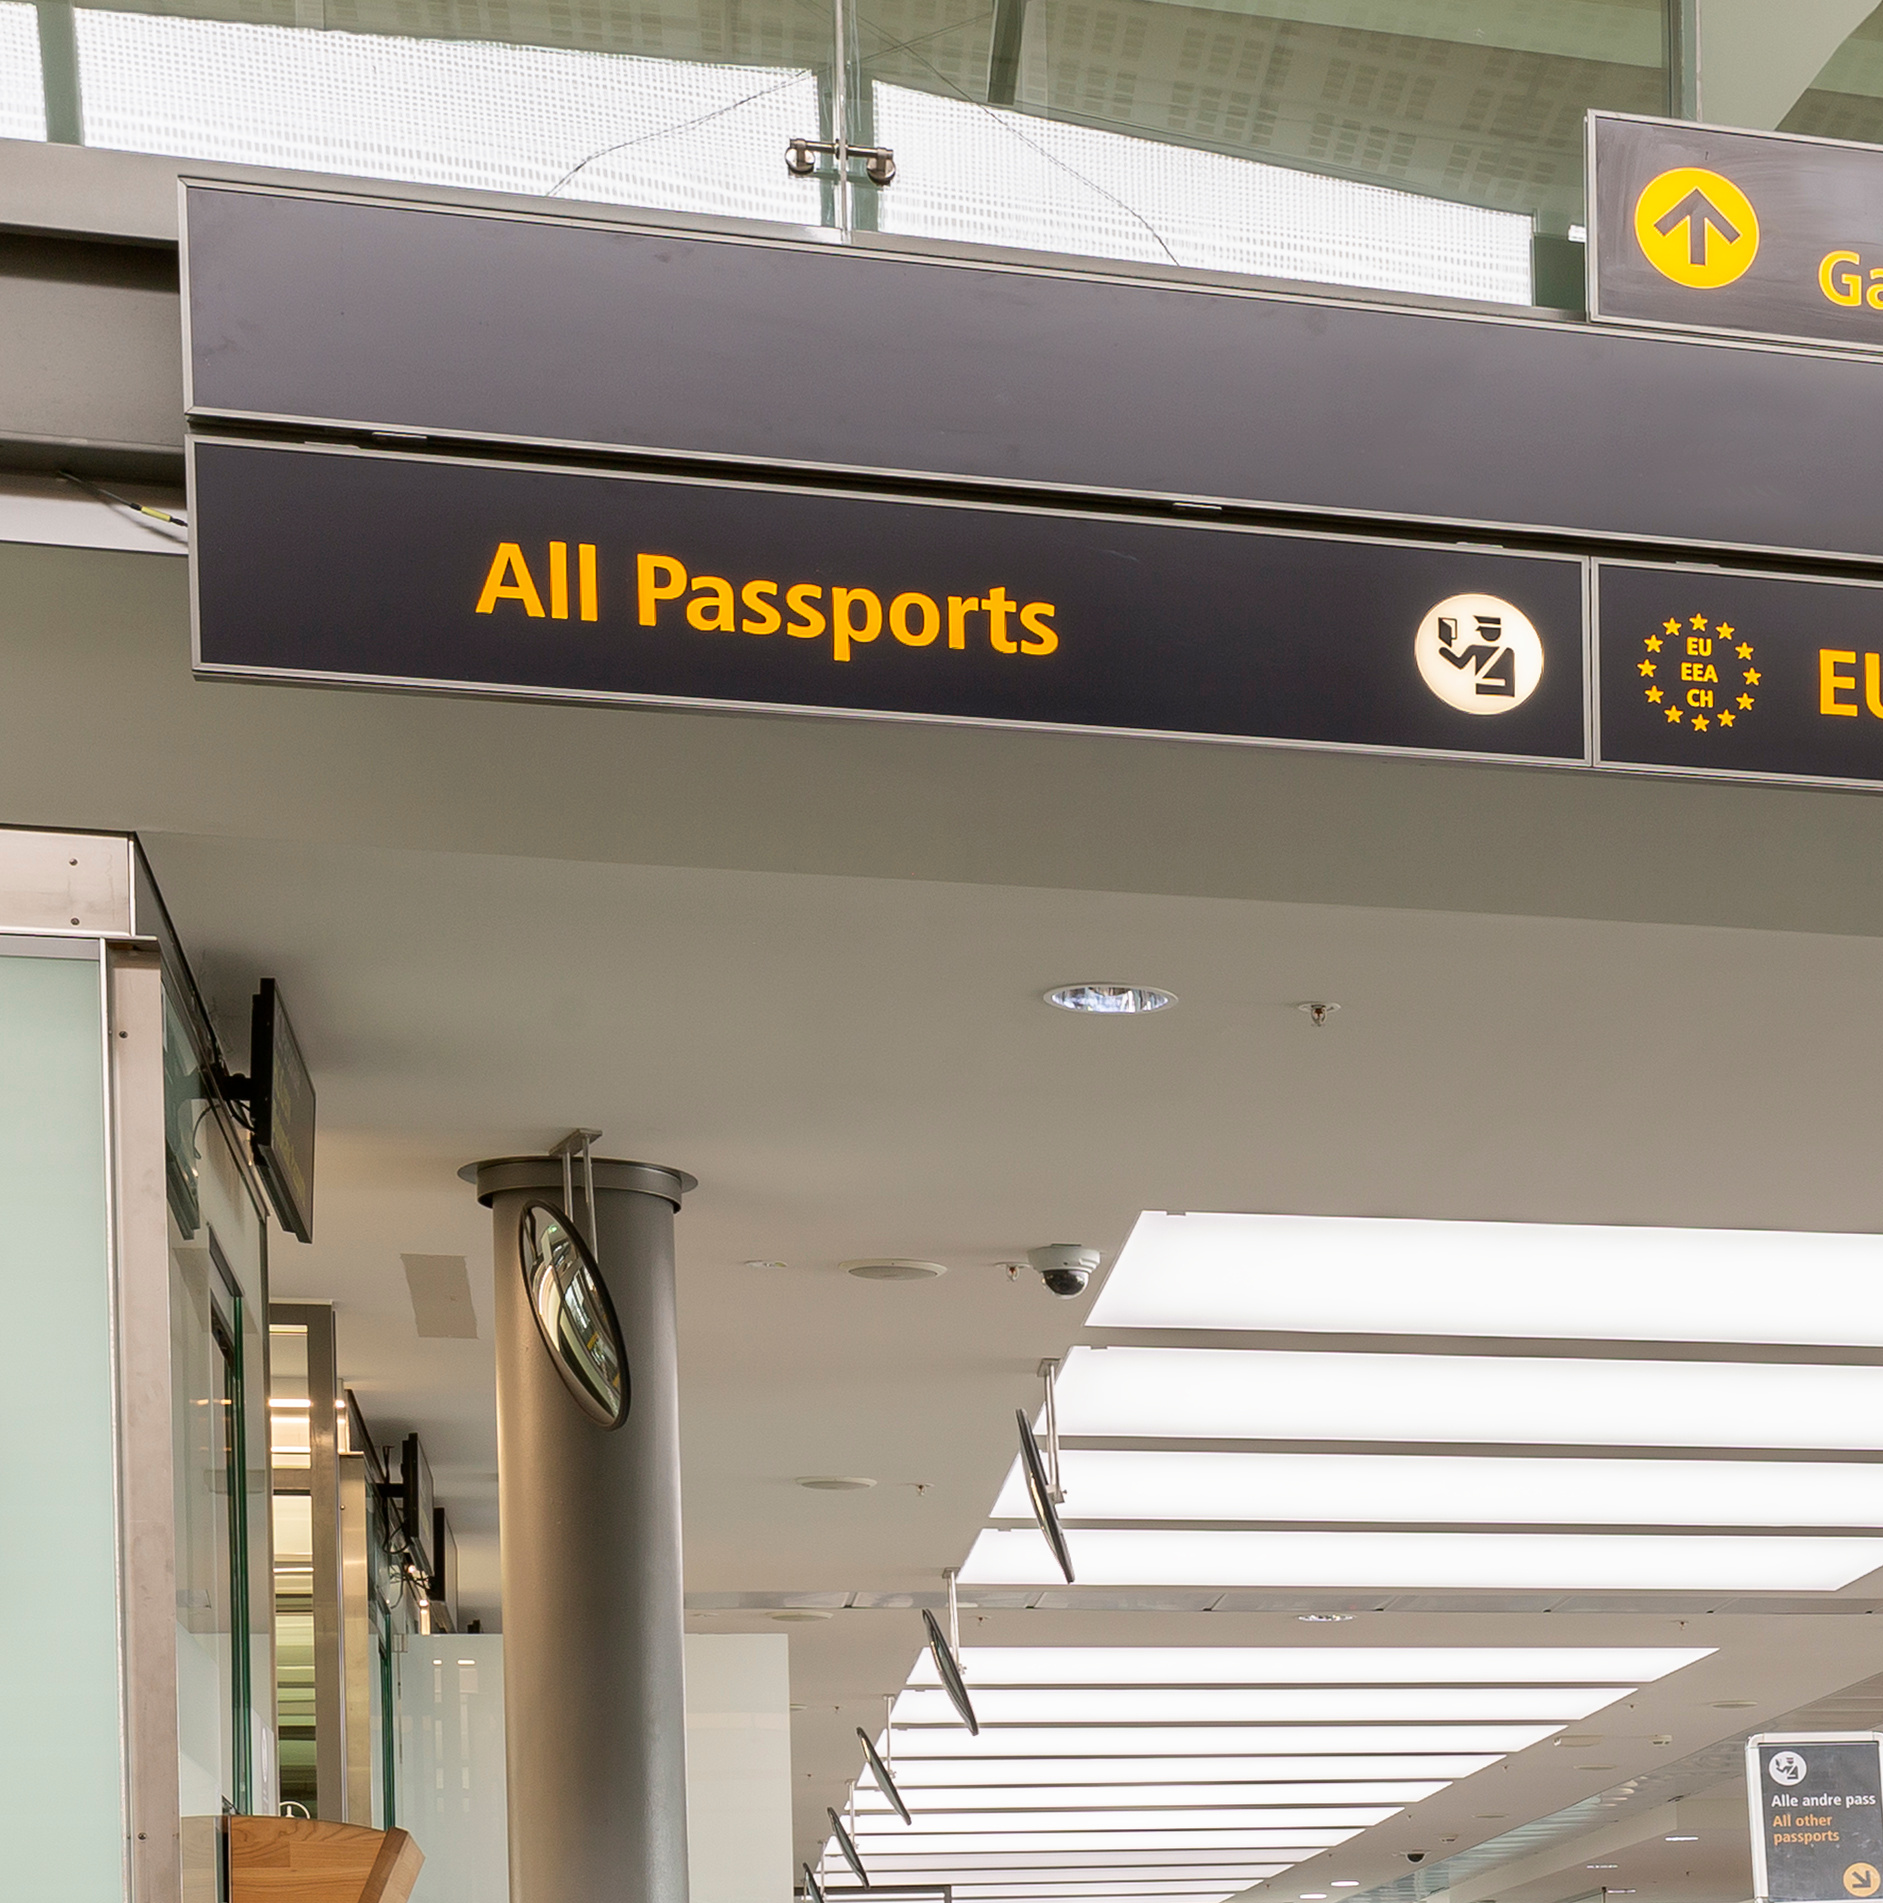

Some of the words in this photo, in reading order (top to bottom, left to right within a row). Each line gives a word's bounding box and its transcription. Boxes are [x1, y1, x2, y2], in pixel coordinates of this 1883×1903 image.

[475, 540, 599, 622] All
[636, 552, 1060, 663] Passports
[1686, 636, 1713, 657] EU
[1680, 661, 1719, 683] EEA
[1686, 687, 1714, 708] CH
[1771, 1793, 1799, 1808] Alle
[1802, 1792, 1842, 1807] andre
[1846, 1793, 1877, 1809] pass
[1773, 1813, 1792, 1827] All
[1795, 1812, 1833, 1827] other
[1773, 1830, 1841, 1847] passports
